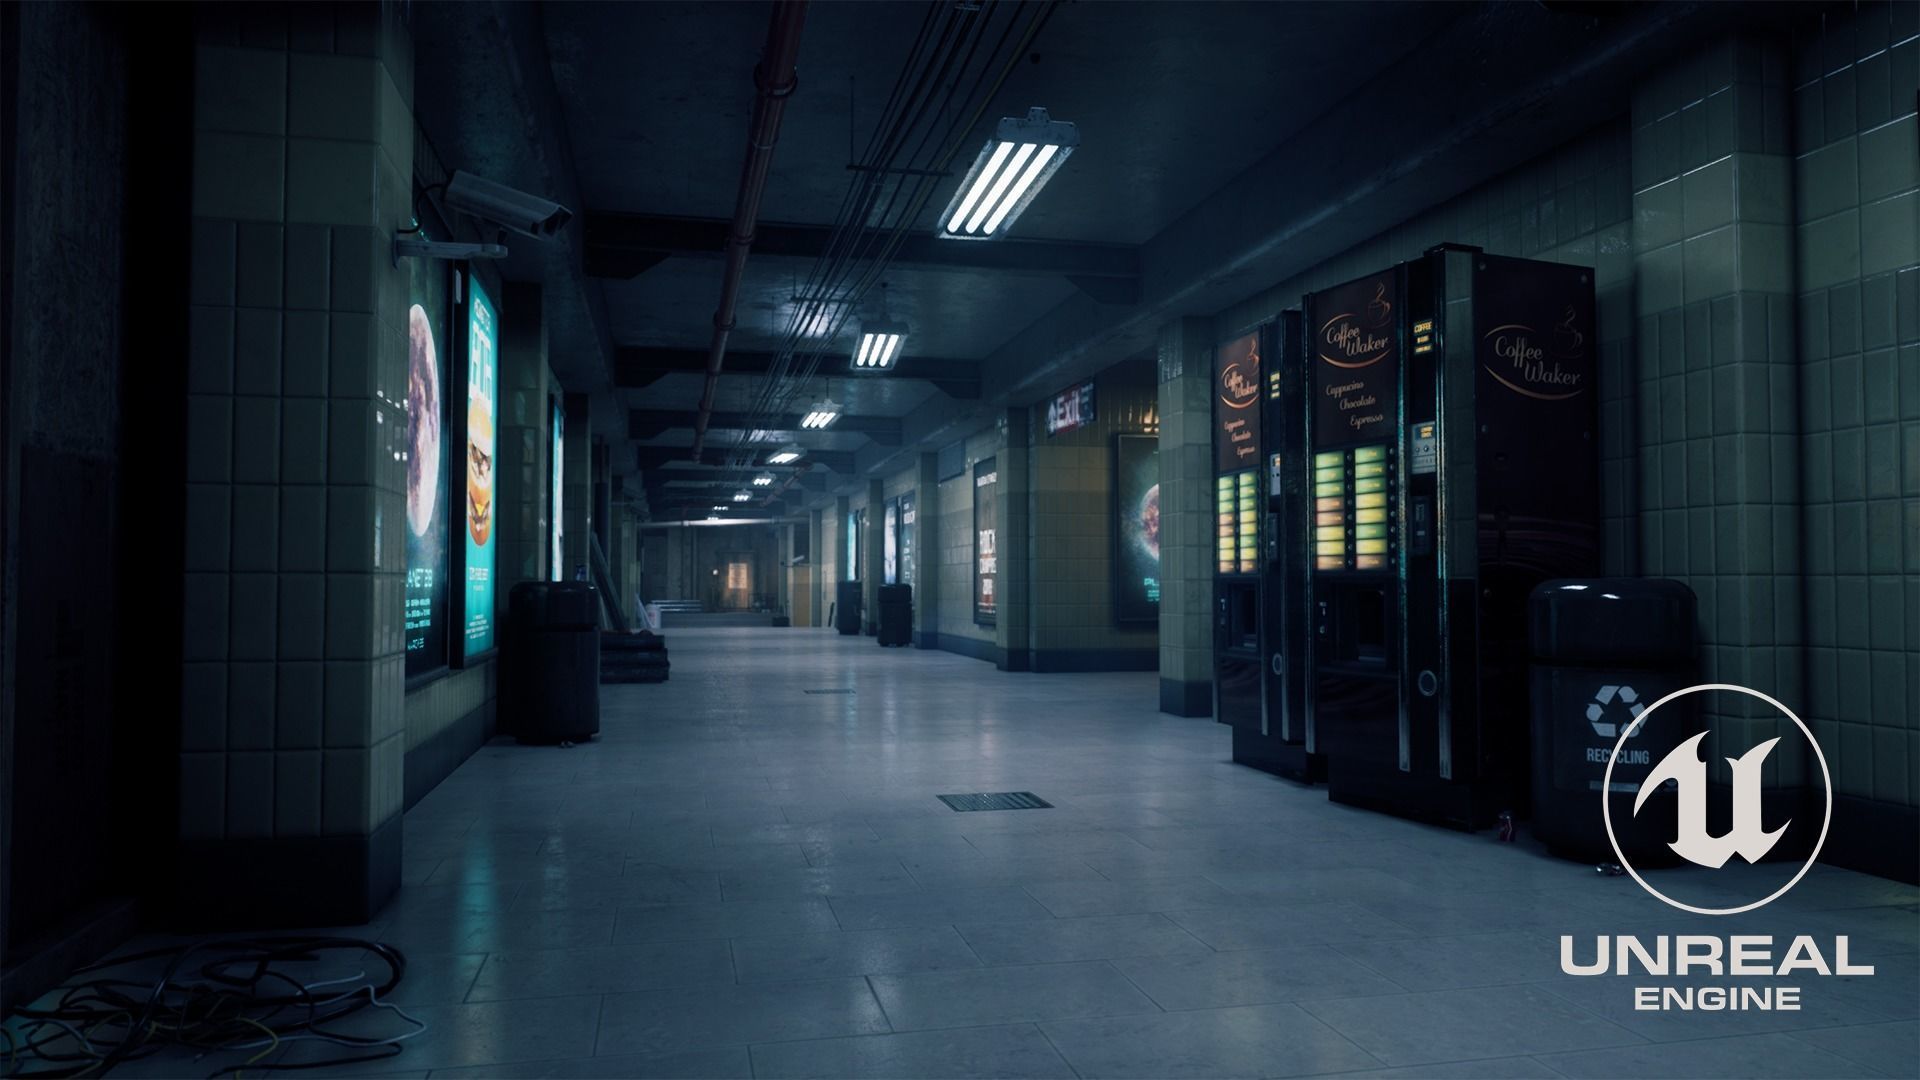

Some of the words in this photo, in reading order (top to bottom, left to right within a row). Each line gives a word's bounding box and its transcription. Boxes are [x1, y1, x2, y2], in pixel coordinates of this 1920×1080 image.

[1326, 323, 1360, 350] Coffee
[1346, 334, 1389, 356] Waker
[1495, 335, 1543, 368] Coffee
[1524, 361, 1581, 385] Waker
[1057, 390, 1080, 428] Exit
[1340, 396, 1376, 411] Chocolate
